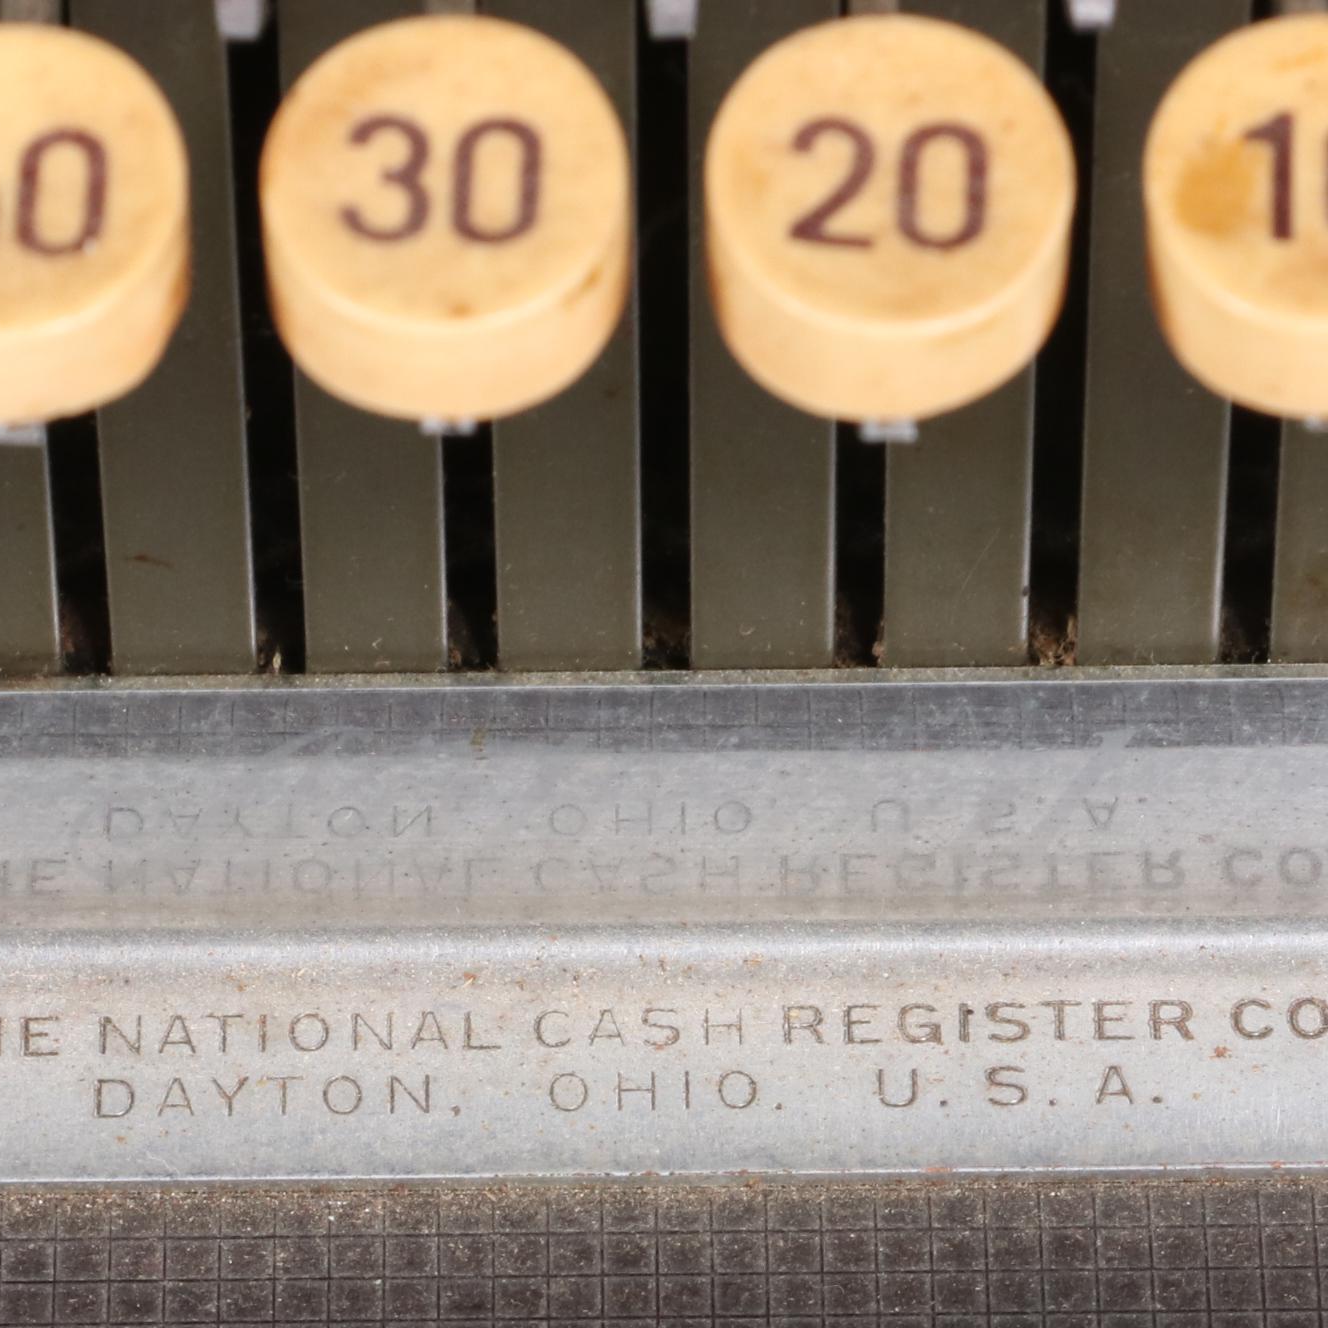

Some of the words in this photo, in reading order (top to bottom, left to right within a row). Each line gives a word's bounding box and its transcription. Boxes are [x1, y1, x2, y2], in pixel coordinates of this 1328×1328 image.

[341, 114, 543, 245] 30
[786, 116, 989, 253] 20
[97, 1010, 502, 1057] NATIONAL
[533, 1007, 743, 1048] CASH
[782, 1000, 1196, 1046] REGISTER
